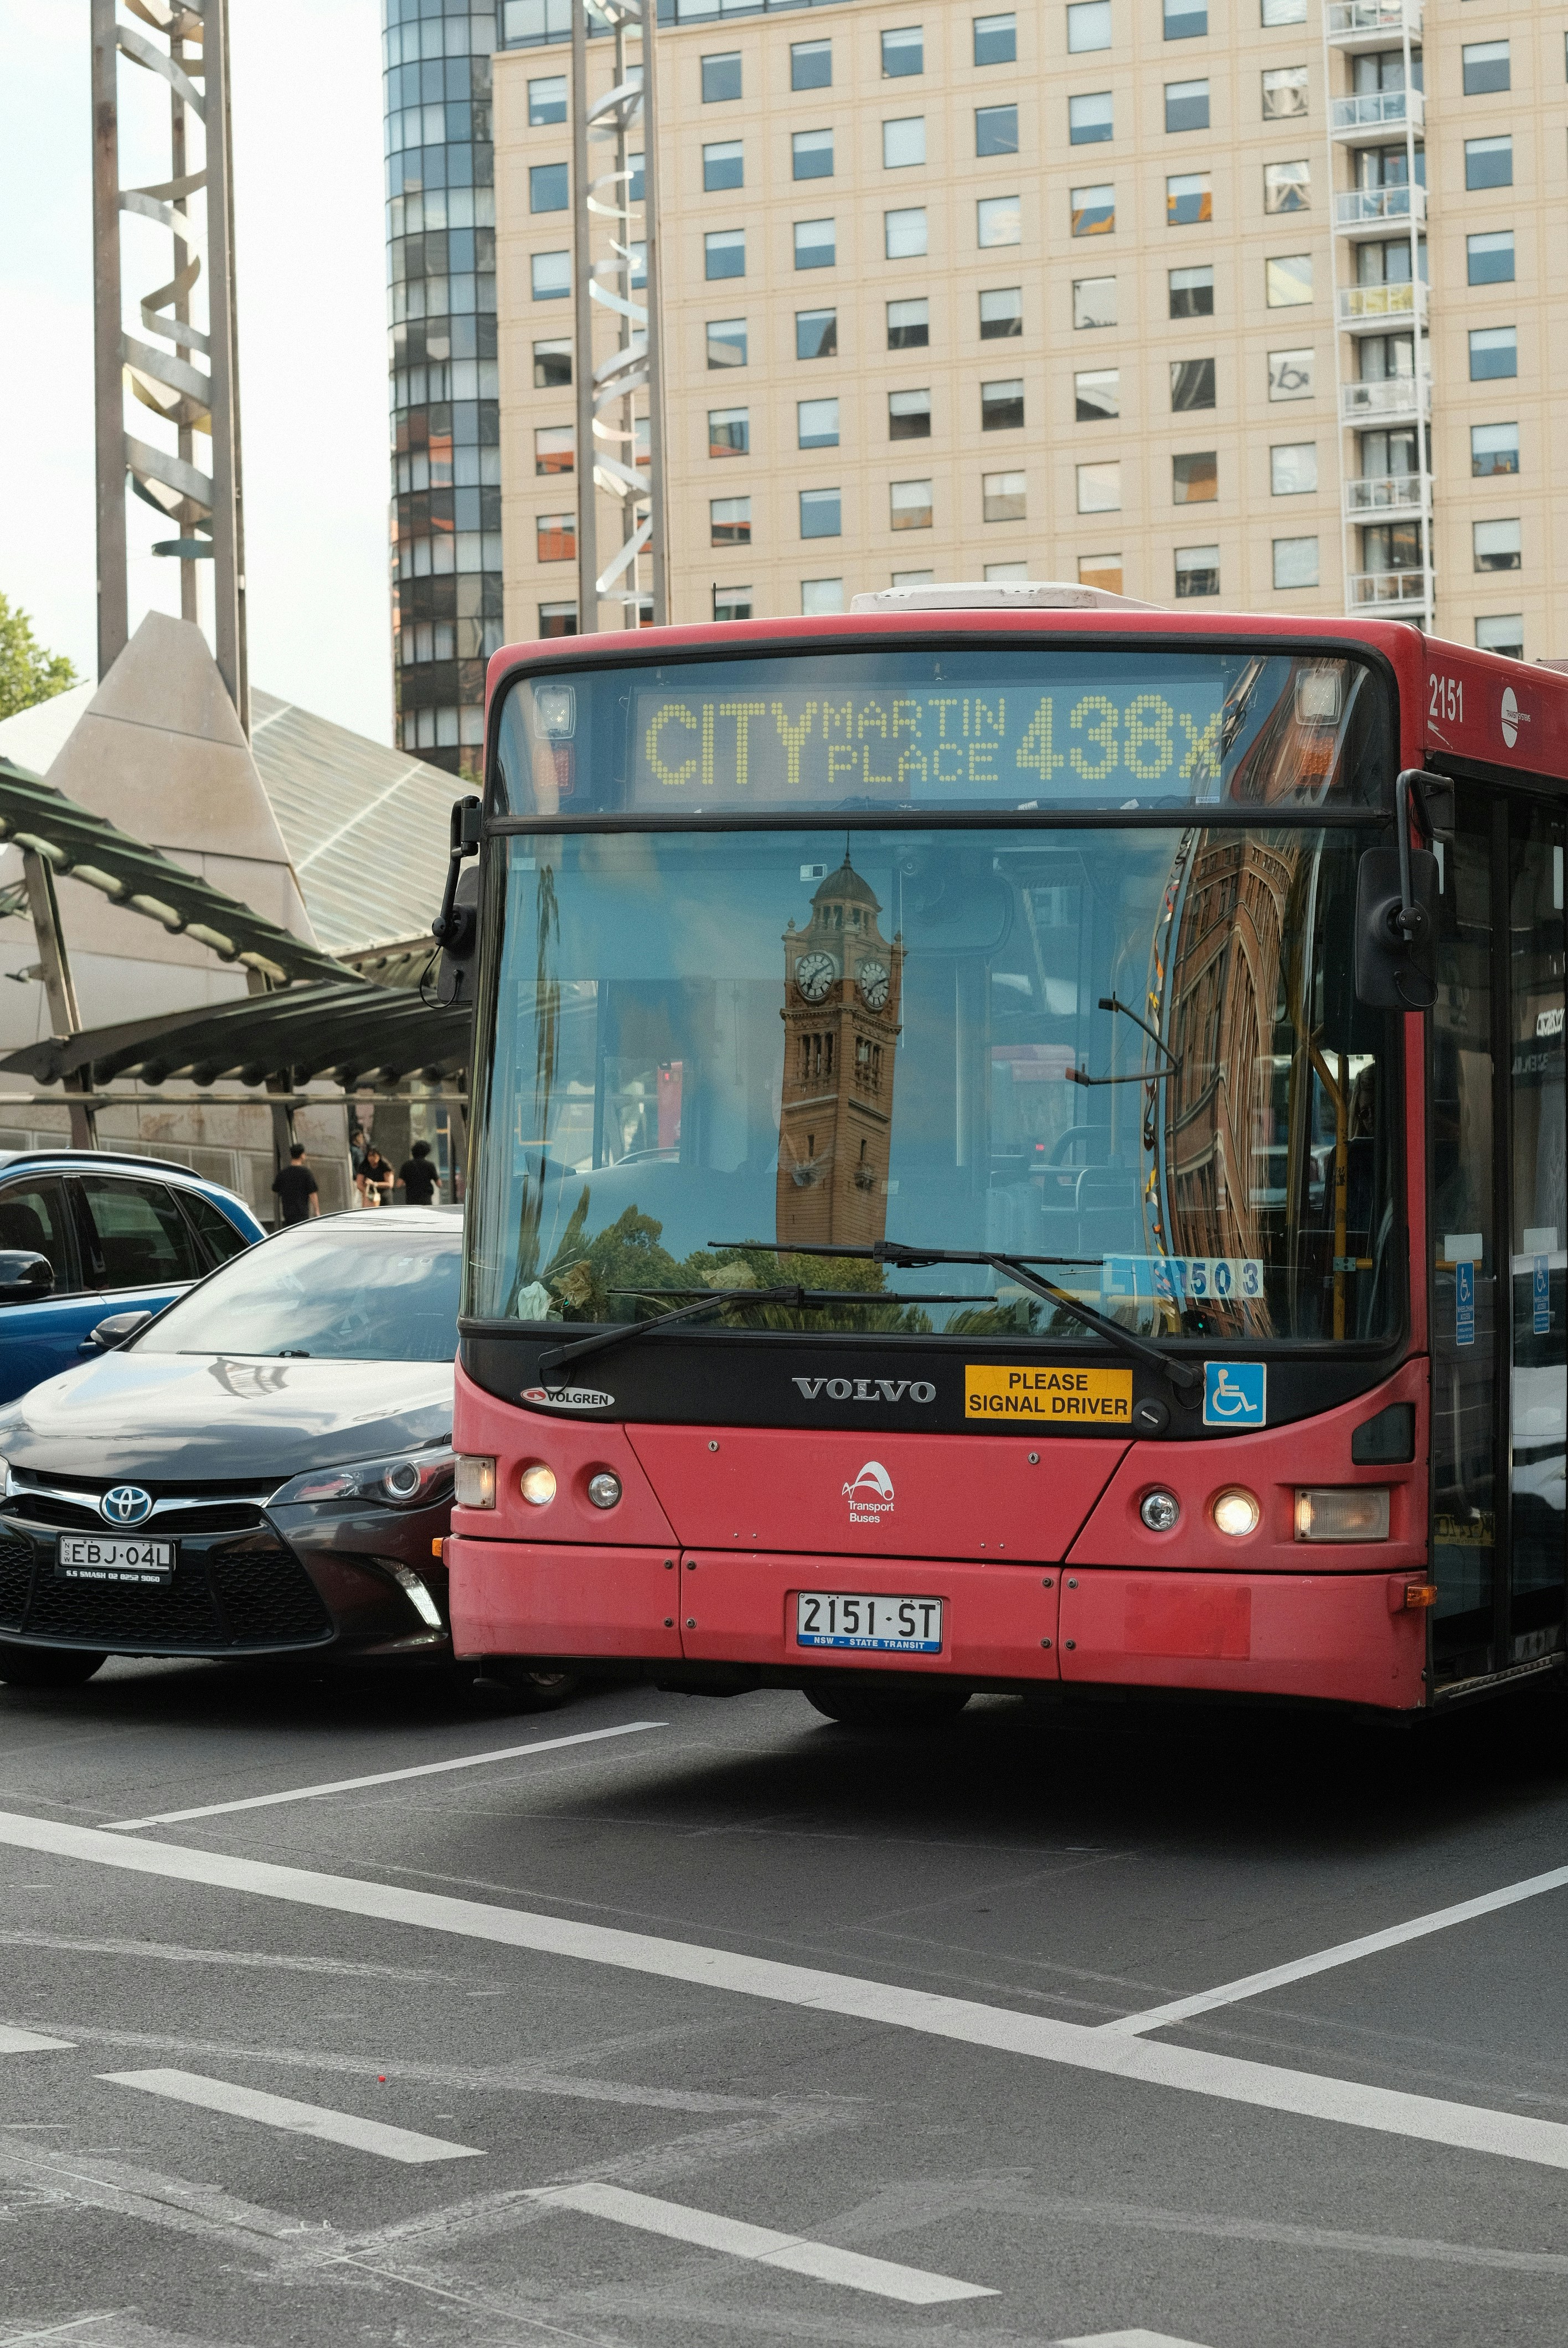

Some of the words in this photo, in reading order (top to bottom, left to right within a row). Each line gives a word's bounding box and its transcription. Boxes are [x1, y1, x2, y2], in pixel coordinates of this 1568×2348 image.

[1428, 673, 1463, 723] 2151
[823, 698, 1005, 739] MARTIN
[646, 701, 818, 785] CITY
[828, 743, 998, 783] PLACE
[791, 1377, 937, 1403] VOLVO
[1009, 1372, 1089, 1392] PLEASE
[547, 1392, 609, 1405] VOLGREN
[969, 1394, 1046, 1413] SIGNAL
[1052, 1397, 1128, 1415] DRIVER
[848, 1500, 894, 1513] Transport
[849, 1512, 880, 1523] Buses
[79, 1571, 106, 1579] SMASH
[813, 1636, 834, 1645] NSW
[849, 1638, 878, 1647] STATE
[883, 1640, 925, 1650] TRANSIT
